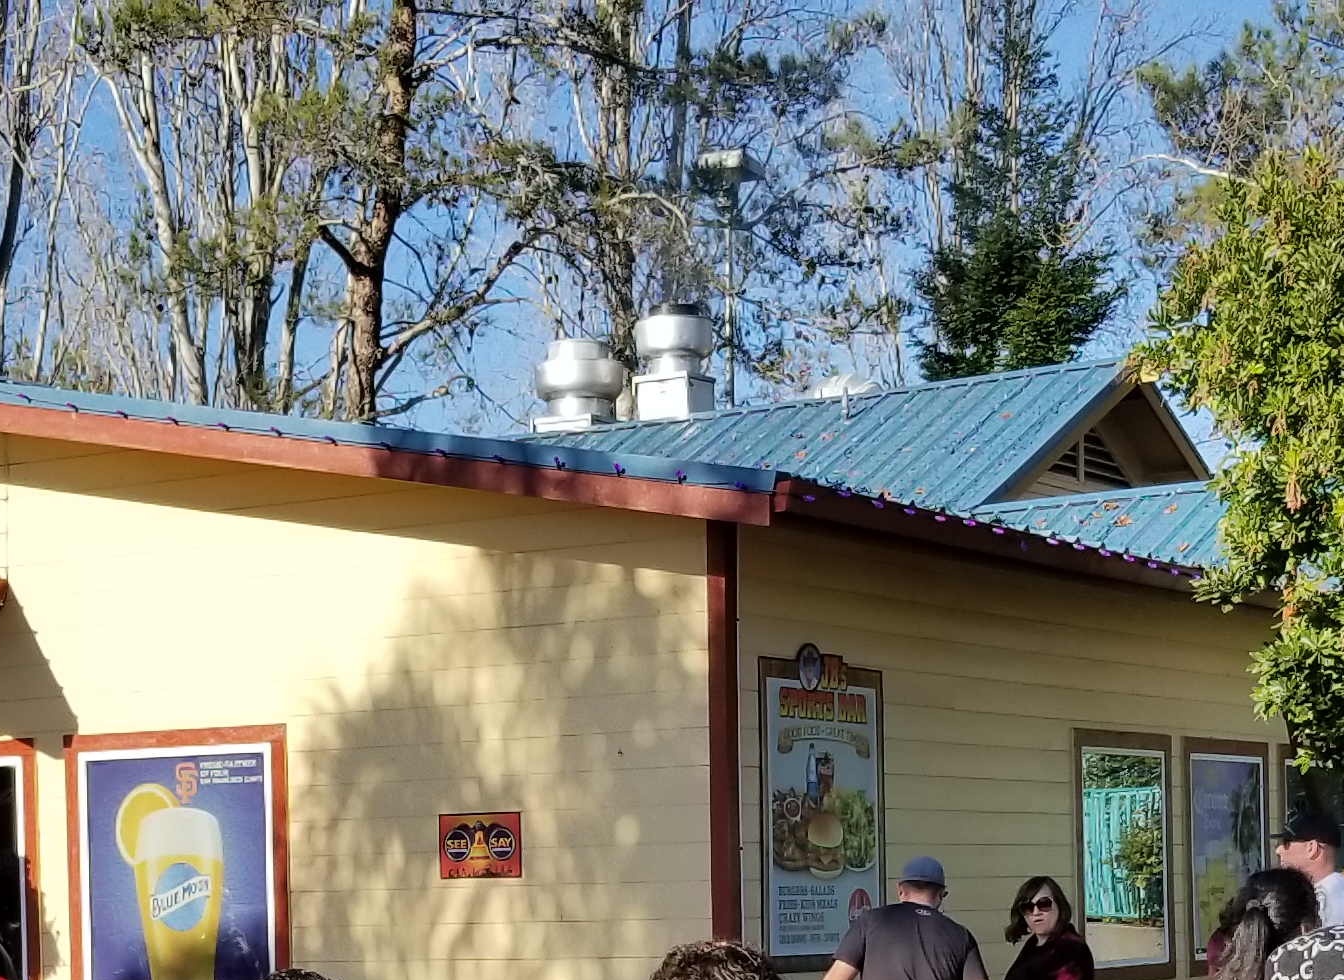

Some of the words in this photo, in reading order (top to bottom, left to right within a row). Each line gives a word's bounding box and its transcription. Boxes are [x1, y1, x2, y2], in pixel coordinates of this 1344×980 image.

[447, 839, 467, 849] SEE
[490, 837, 512, 847] SAY
[152, 891, 179, 918] BLUE
[182, 879, 210, 901] MOON
